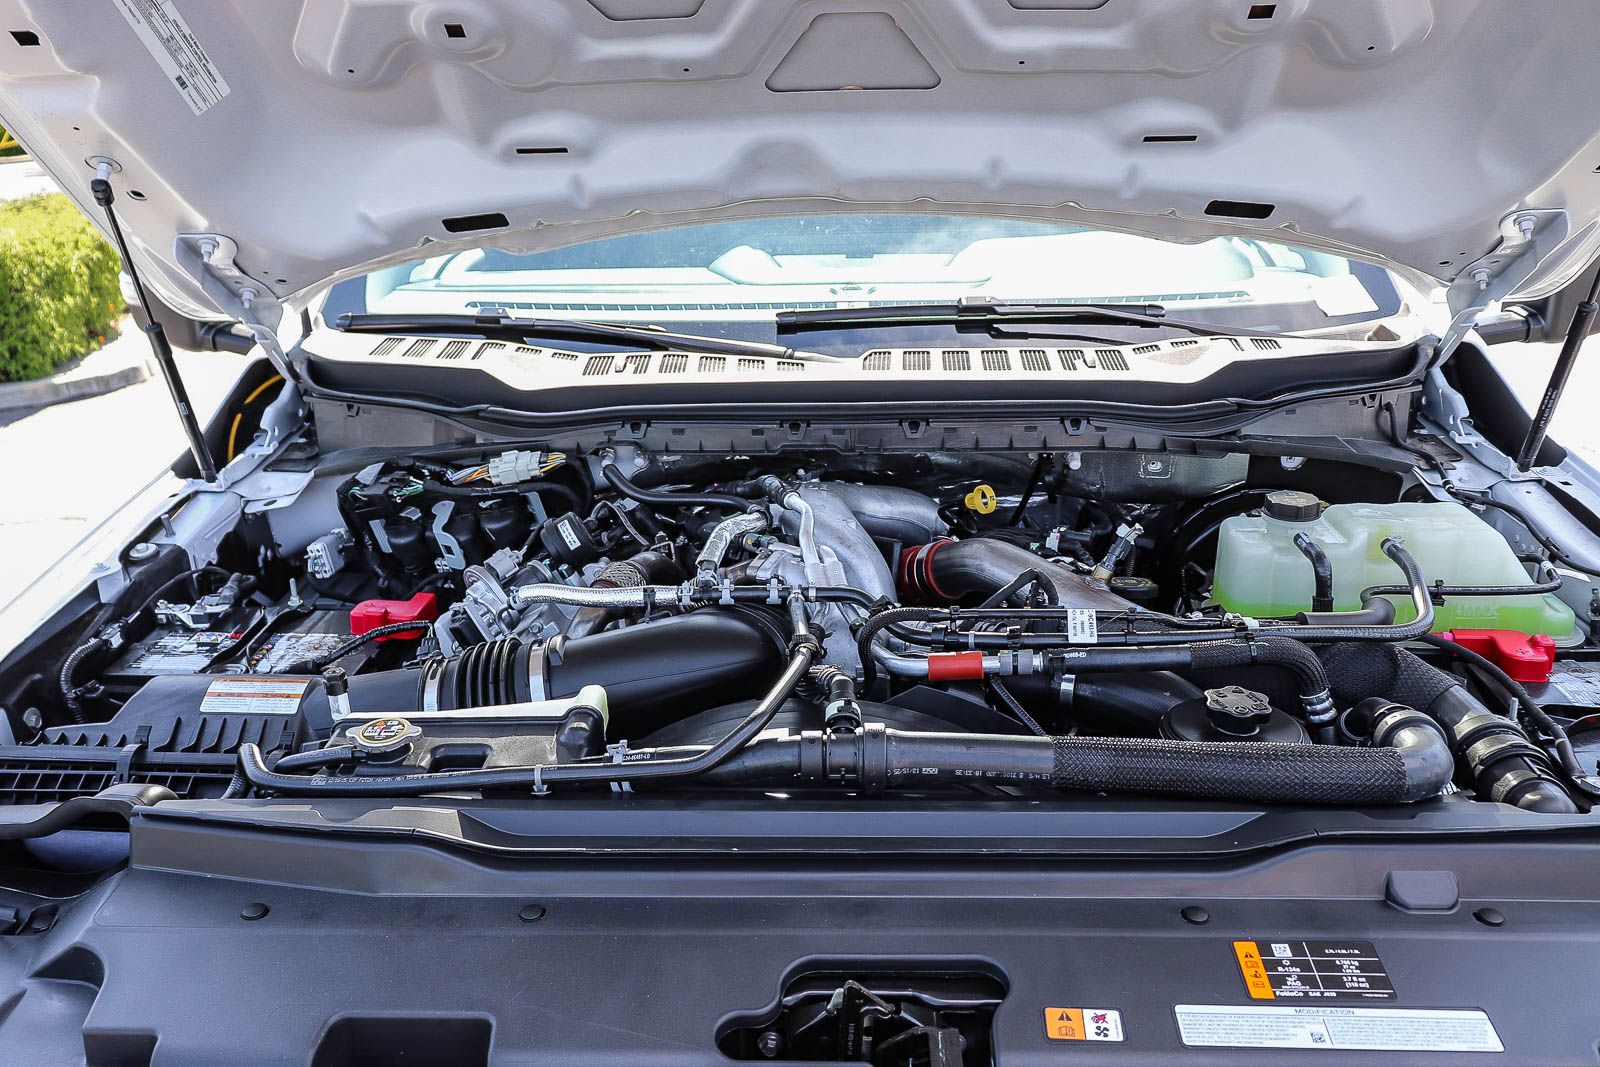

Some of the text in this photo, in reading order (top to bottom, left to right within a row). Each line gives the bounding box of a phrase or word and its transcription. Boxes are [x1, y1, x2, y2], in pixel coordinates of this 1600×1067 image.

[172, 19, 217, 83] VEHICLE EMISSION CONTROL INFORMATION
[1294, 1008, 1355, 1016] MODIFICATION
